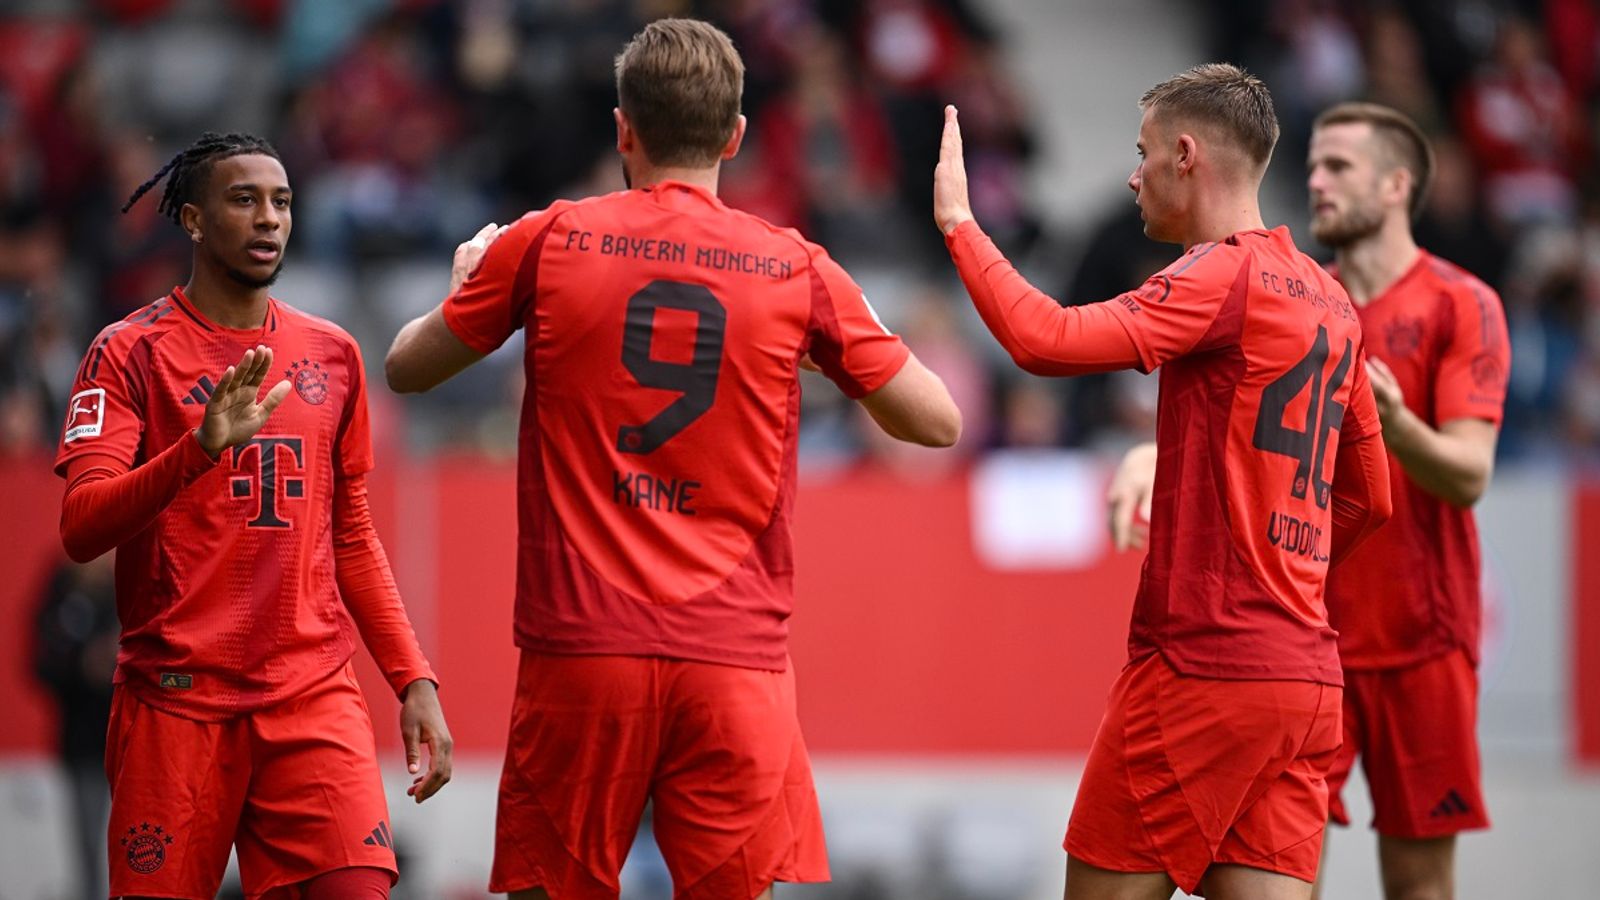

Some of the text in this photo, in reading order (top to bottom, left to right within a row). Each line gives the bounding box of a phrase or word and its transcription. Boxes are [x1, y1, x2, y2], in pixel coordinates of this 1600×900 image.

[565, 231, 791, 279] FC BAYERN MÜNCHEN
[1261, 271, 1281, 293] FC
[617, 280, 726, 456] 9
[229, 434, 305, 530] T
[612, 470, 701, 515] KANE
